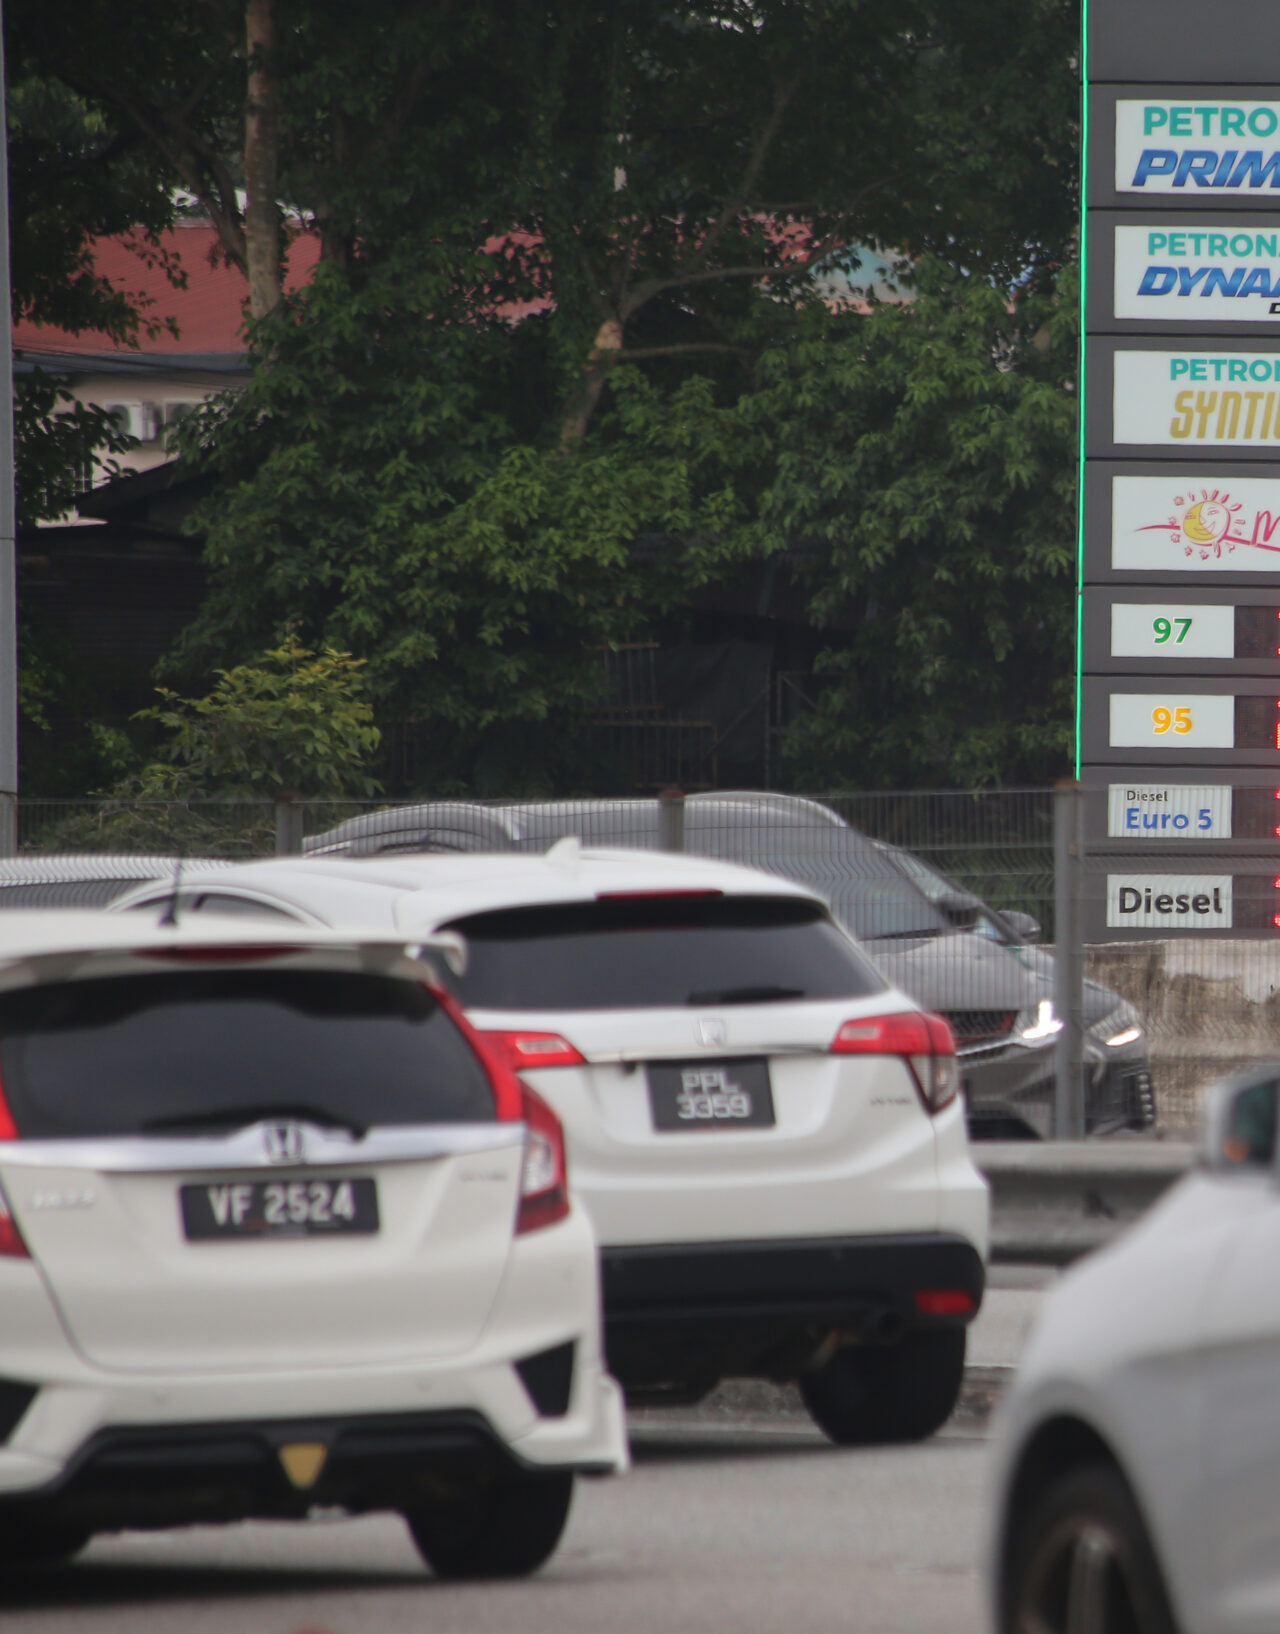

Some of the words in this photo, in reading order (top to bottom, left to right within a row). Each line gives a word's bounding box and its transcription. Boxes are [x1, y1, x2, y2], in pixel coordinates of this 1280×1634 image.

[1152, 617, 1194, 645] 97
[1151, 707, 1194, 735] 95
[1126, 790, 1169, 802] Diesel
[1125, 807, 1190, 831] Euro
[1197, 808, 1213, 831] 5
[1118, 887, 1223, 915] Diesel
[680, 1069, 740, 1094] PPL
[207, 1184, 253, 1227] VF
[263, 1180, 356, 1225] 2524
